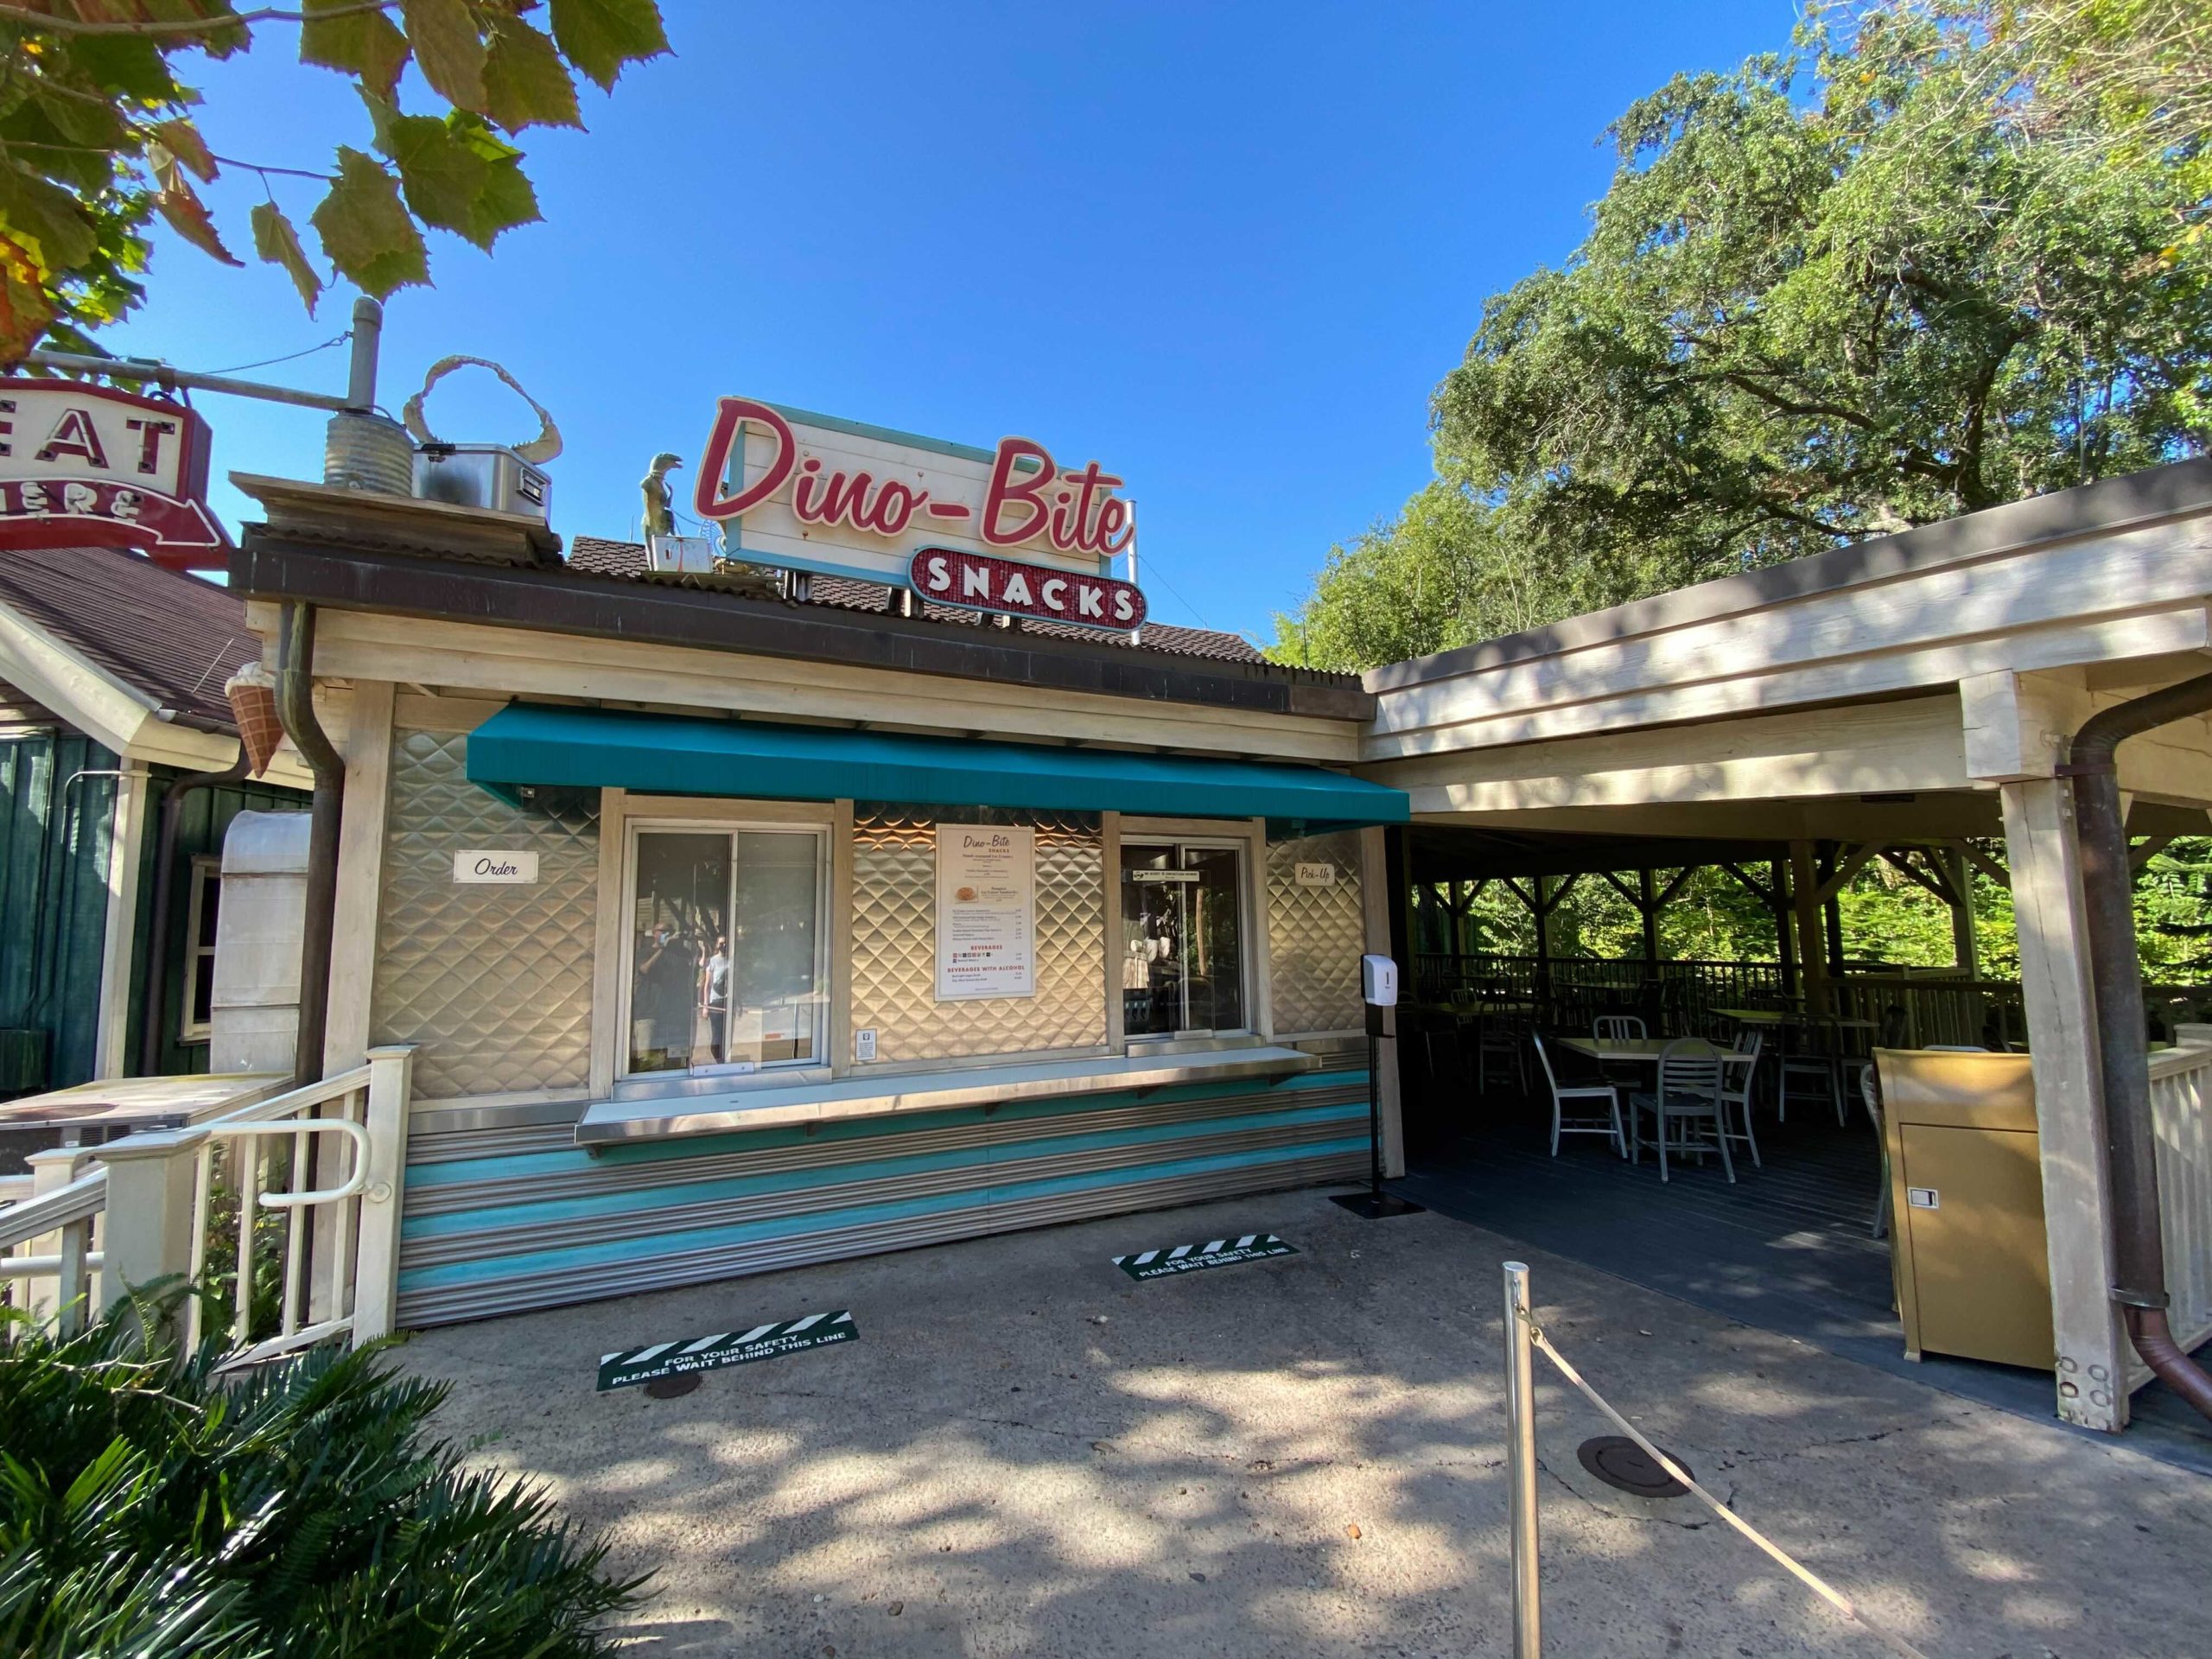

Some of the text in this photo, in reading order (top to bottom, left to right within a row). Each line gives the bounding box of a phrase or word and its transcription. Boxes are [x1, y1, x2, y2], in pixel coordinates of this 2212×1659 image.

[694, 395, 1135, 556] Dino-Bite
[0, 481, 142, 524] ERE
[927, 557, 1135, 620] SNACKS
[963, 834, 1010, 848] Dino-Bite
[474, 858, 518, 875] Order
[1300, 866, 1330, 882] Pick-Up
[1139, 1247, 1290, 1277] PLEASE WAIT BEHIND THIS LINE
[1165, 1248, 1252, 1267] FOR YOUR SAFETY
[612, 1332, 847, 1385] PLEASE WAIT BEHIND THIS LINE
[664, 1334, 798, 1367] FOR YOUR SAFETY
